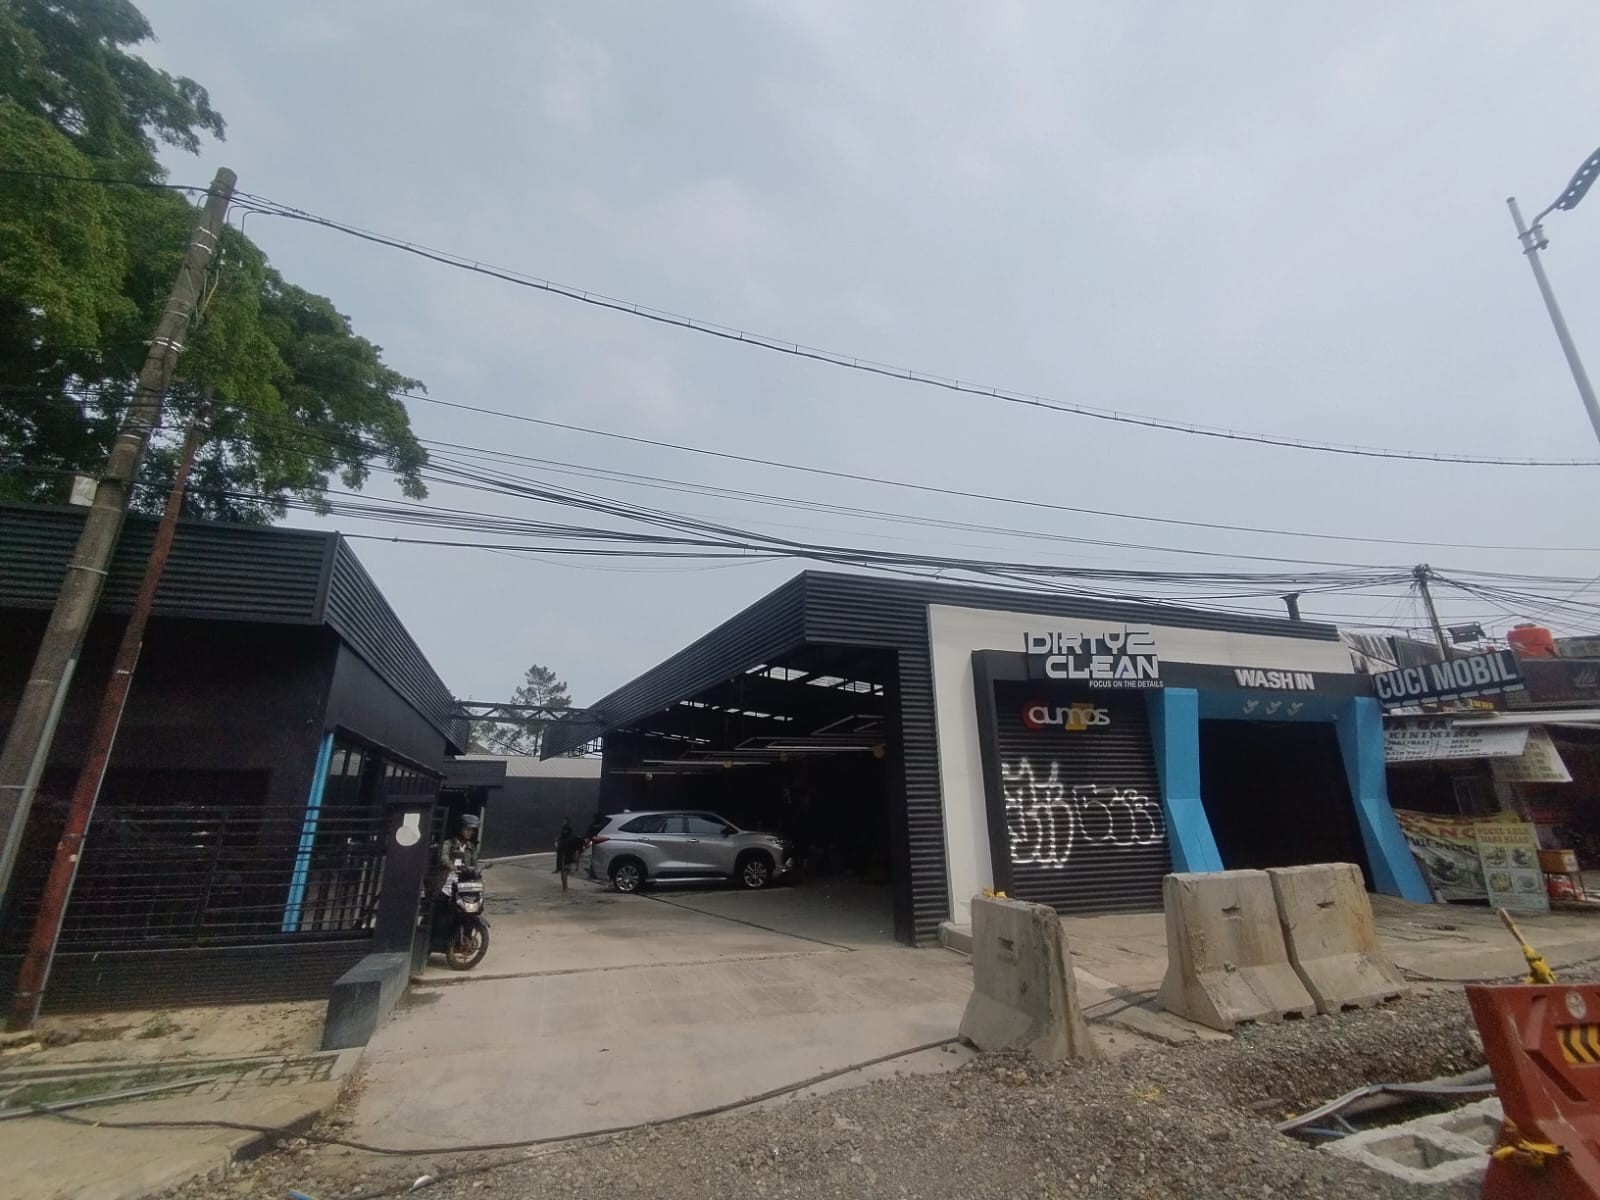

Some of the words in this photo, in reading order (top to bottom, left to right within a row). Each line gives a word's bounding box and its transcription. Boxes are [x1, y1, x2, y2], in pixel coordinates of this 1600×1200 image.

[1045, 655, 1160, 679] CLEAN
[1375, 666, 1429, 699] CUCI
[1430, 652, 1517, 691] MOBIL
[1089, 680, 1112, 688] FOCUS
[1113, 680, 1123, 688] ON
[1124, 680, 1137, 688] THE
[1138, 680, 1164, 688] DETAILS
